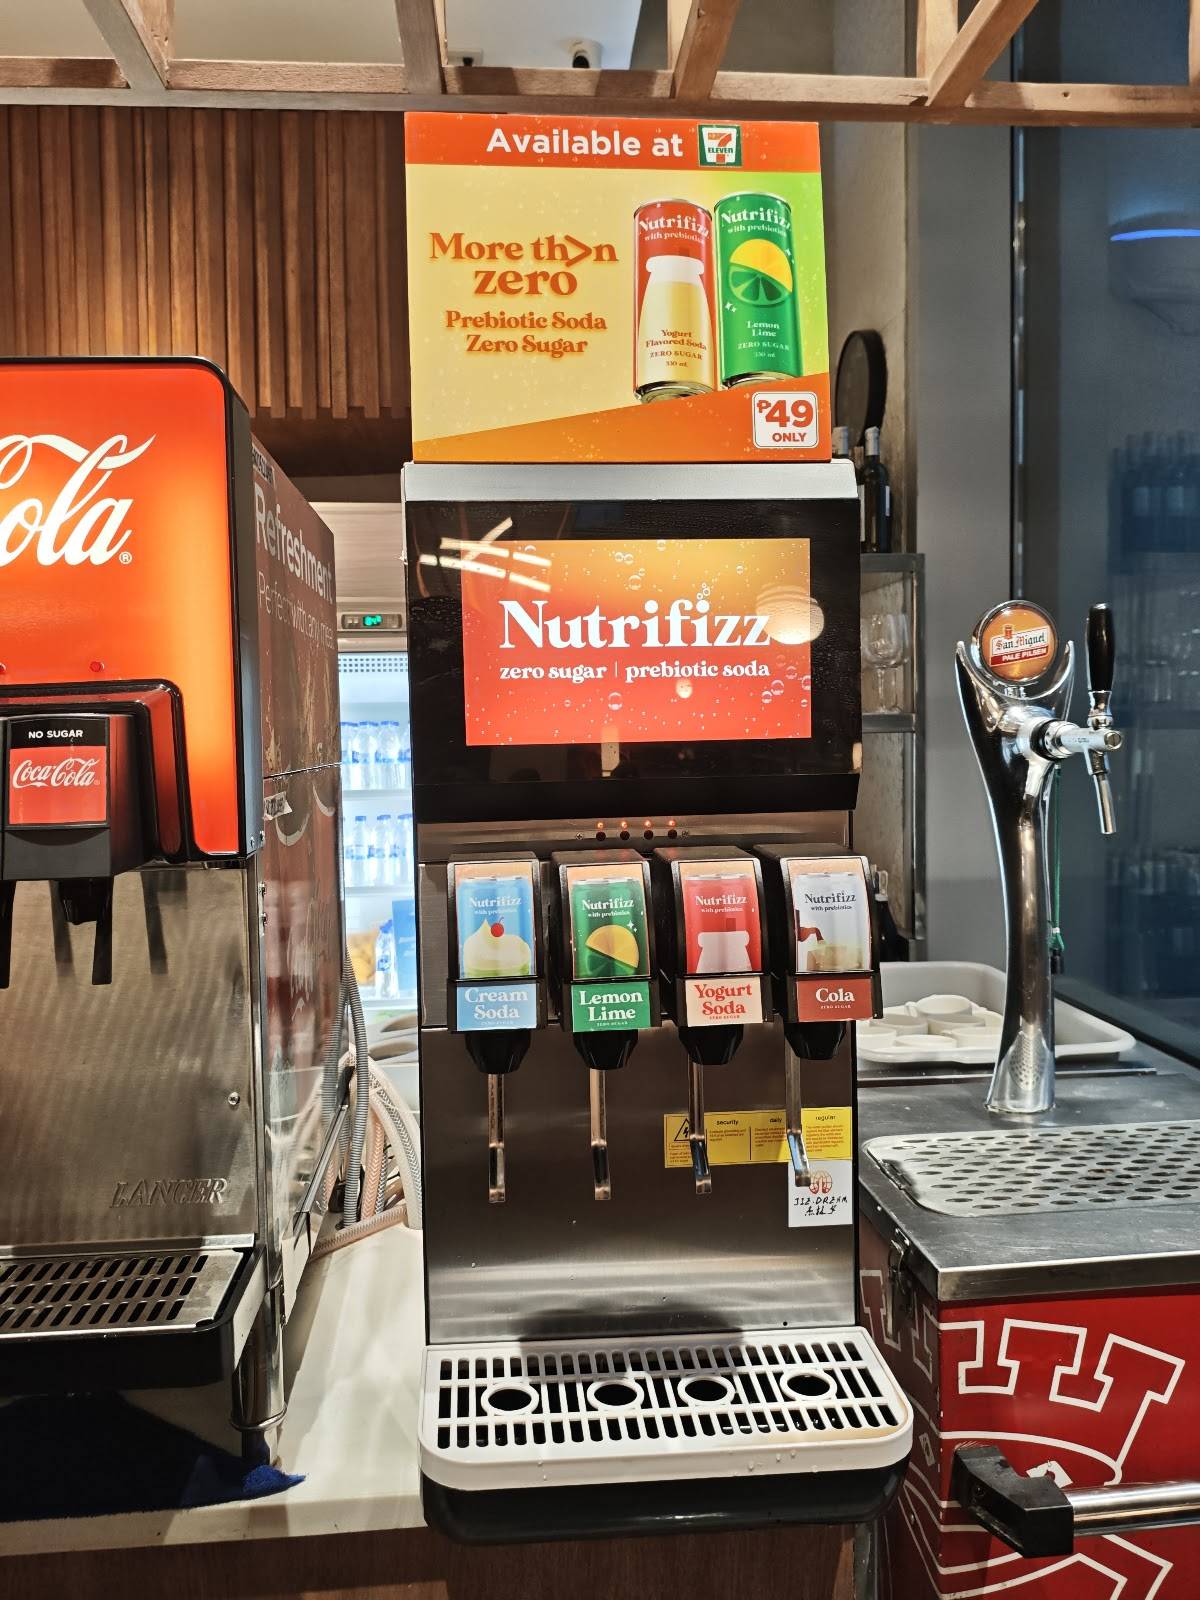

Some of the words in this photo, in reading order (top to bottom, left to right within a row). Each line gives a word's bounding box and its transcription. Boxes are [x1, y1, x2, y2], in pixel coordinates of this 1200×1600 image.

[486, 128, 641, 157] Available
[651, 133, 684, 157] at
[429, 231, 524, 261] More
[473, 270, 578, 296] zero
[445, 310, 548, 330] Prebiotic
[551, 311, 608, 330] Soda
[745, 320, 780, 330] Lemon
[660, 329, 693, 338] Yogurt
[751, 329, 777, 337] Lime
[466, 334, 519, 353] Zero
[521, 334, 589, 359] Sugar
[645, 338, 685, 348] Flavored
[686, 339, 707, 351] Soda
[736, 341, 760, 350] ZERO
[761, 341, 790, 351] SUGAR
[649, 350, 672, 358] ZERO
[673, 350, 703, 361] SUGAR
[772, 432, 807, 442] ONLY
[254, 481, 334, 606] Refreshment
[498, 598, 772, 649] Nutrifizz
[995, 638, 1014, 651] San
[1014, 631, 1045, 648] Miguel
[1002, 652, 1021, 662] PALE
[1021, 647, 1047, 659] PILSEN
[499, 664, 545, 680] zero
[547, 664, 608, 684] sugar
[624, 659, 719, 683] prebiotic
[722, 660, 771, 678] soda
[28, 730, 44, 739] NO
[46, 729, 84, 739] SUGAR
[12, 757, 101, 789] Coca-Cola
[468, 895, 522, 908] Nutrifizz
[581, 898, 635, 911] Nutrifizz
[695, 894, 748, 906] Nutrifizz
[804, 892, 857, 904] Nutrifizz
[464, 987, 528, 1003] Cream
[578, 990, 643, 1006] Lemon
[694, 983, 753, 1001] Yogurt
[815, 987, 855, 1003] Cola
[473, 1004, 521, 1020] Soda
[587, 1006, 636, 1022] Lime
[702, 1000, 746, 1016] Soda
[769, 1116, 782, 1124] daily
[109, 1177, 229, 1209] LANCER
